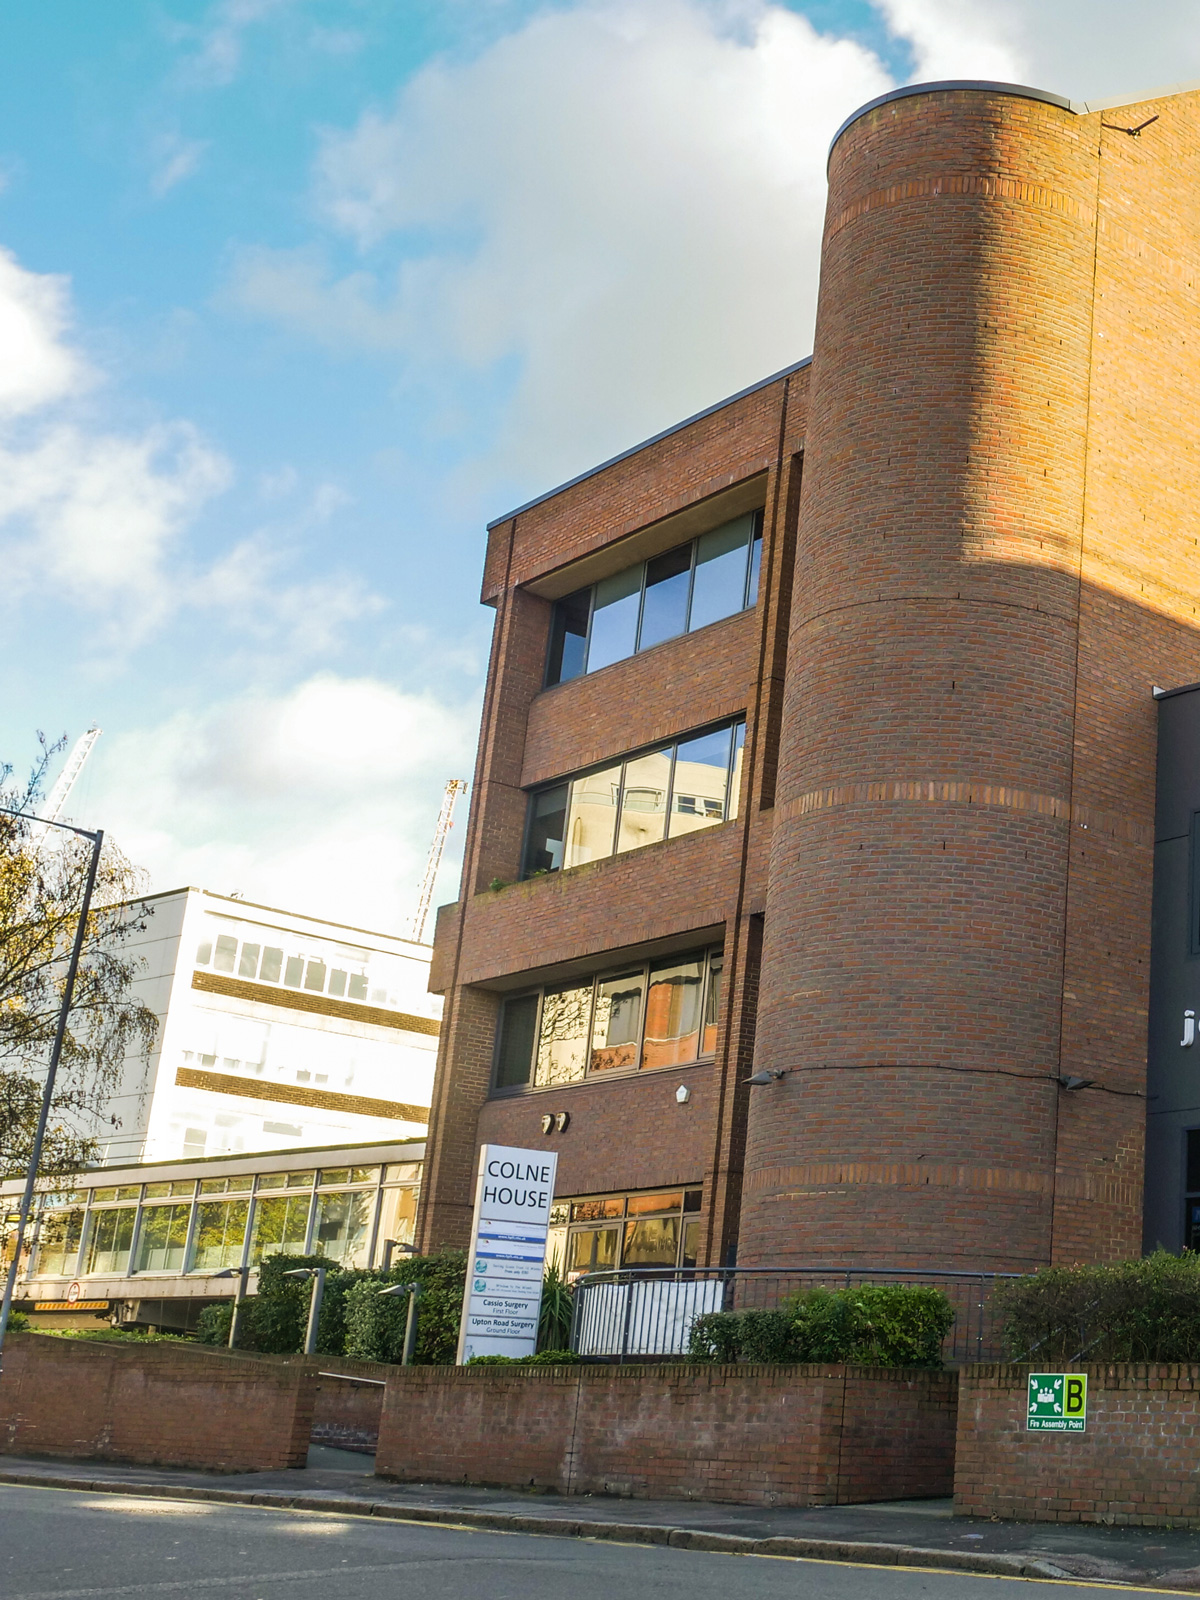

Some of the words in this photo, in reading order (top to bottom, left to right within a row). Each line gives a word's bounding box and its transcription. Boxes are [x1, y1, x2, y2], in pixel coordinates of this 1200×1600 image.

[488, 1161, 550, 1183] COLNE
[484, 1186, 548, 1208] HOUSE
[483, 1299, 503, 1307] Cassio
[504, 1301, 528, 1310] Surgery
[472, 1318, 491, 1326] Upton
[493, 1319, 509, 1327] Road
[511, 1321, 534, 1329] Surgery
[1067, 1380, 1082, 1412] B
[1030, 1419, 1039, 1427] Fire
[1041, 1420, 1067, 1430] Assembly
[1068, 1420, 1083, 1429] Point
